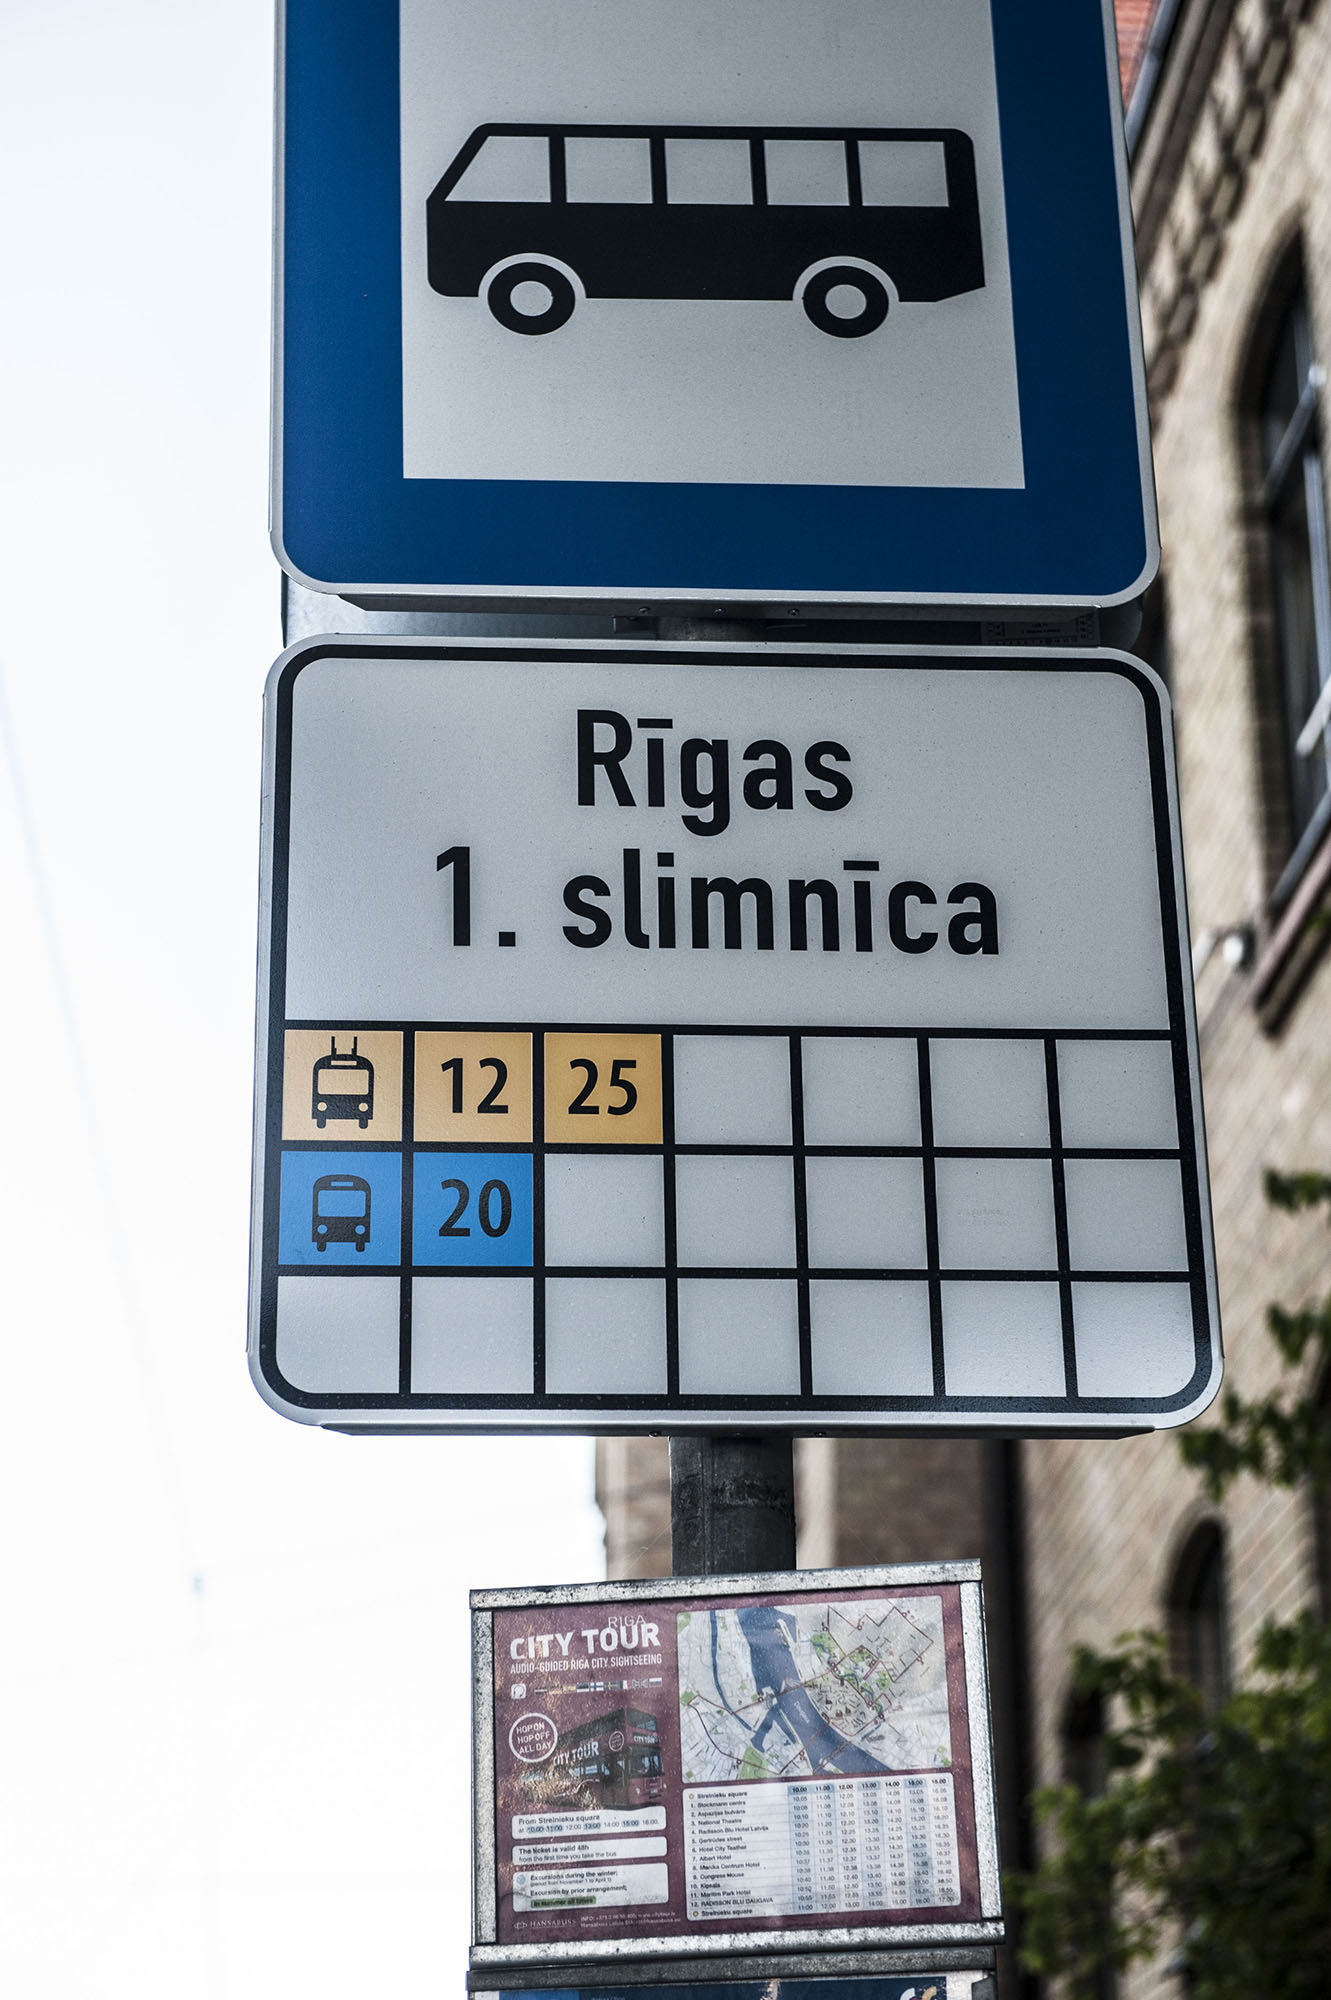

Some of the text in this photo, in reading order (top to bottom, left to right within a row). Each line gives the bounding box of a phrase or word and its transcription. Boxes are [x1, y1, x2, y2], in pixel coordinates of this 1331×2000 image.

[578, 710, 852, 836] Rīgas
[437, 847, 999, 955] 1. slimnīca
[442, 1058, 637, 1115] 12 25
[439, 1179, 512, 1237] 20
[608, 1615, 646, 1628] RIGA
[510, 1623, 661, 1660] CITY TOUR
[510, 1654, 662, 1674] AUDIO-GUIDED RIGA CITY SIGHTSEEING
[516, 1722, 545, 1734] HOP ON
[518, 1732, 550, 1744] HOP OFF
[520, 1742, 552, 1754] ALL DAY
[553, 1752, 570, 1766] CITY
[572, 1740, 600, 1762] TOUR
[530, 1874, 564, 1882] Excursions
[566, 1872, 585, 1880] during
[530, 1888, 560, 1896] Excursion
[562, 1888, 570, 1896] by
